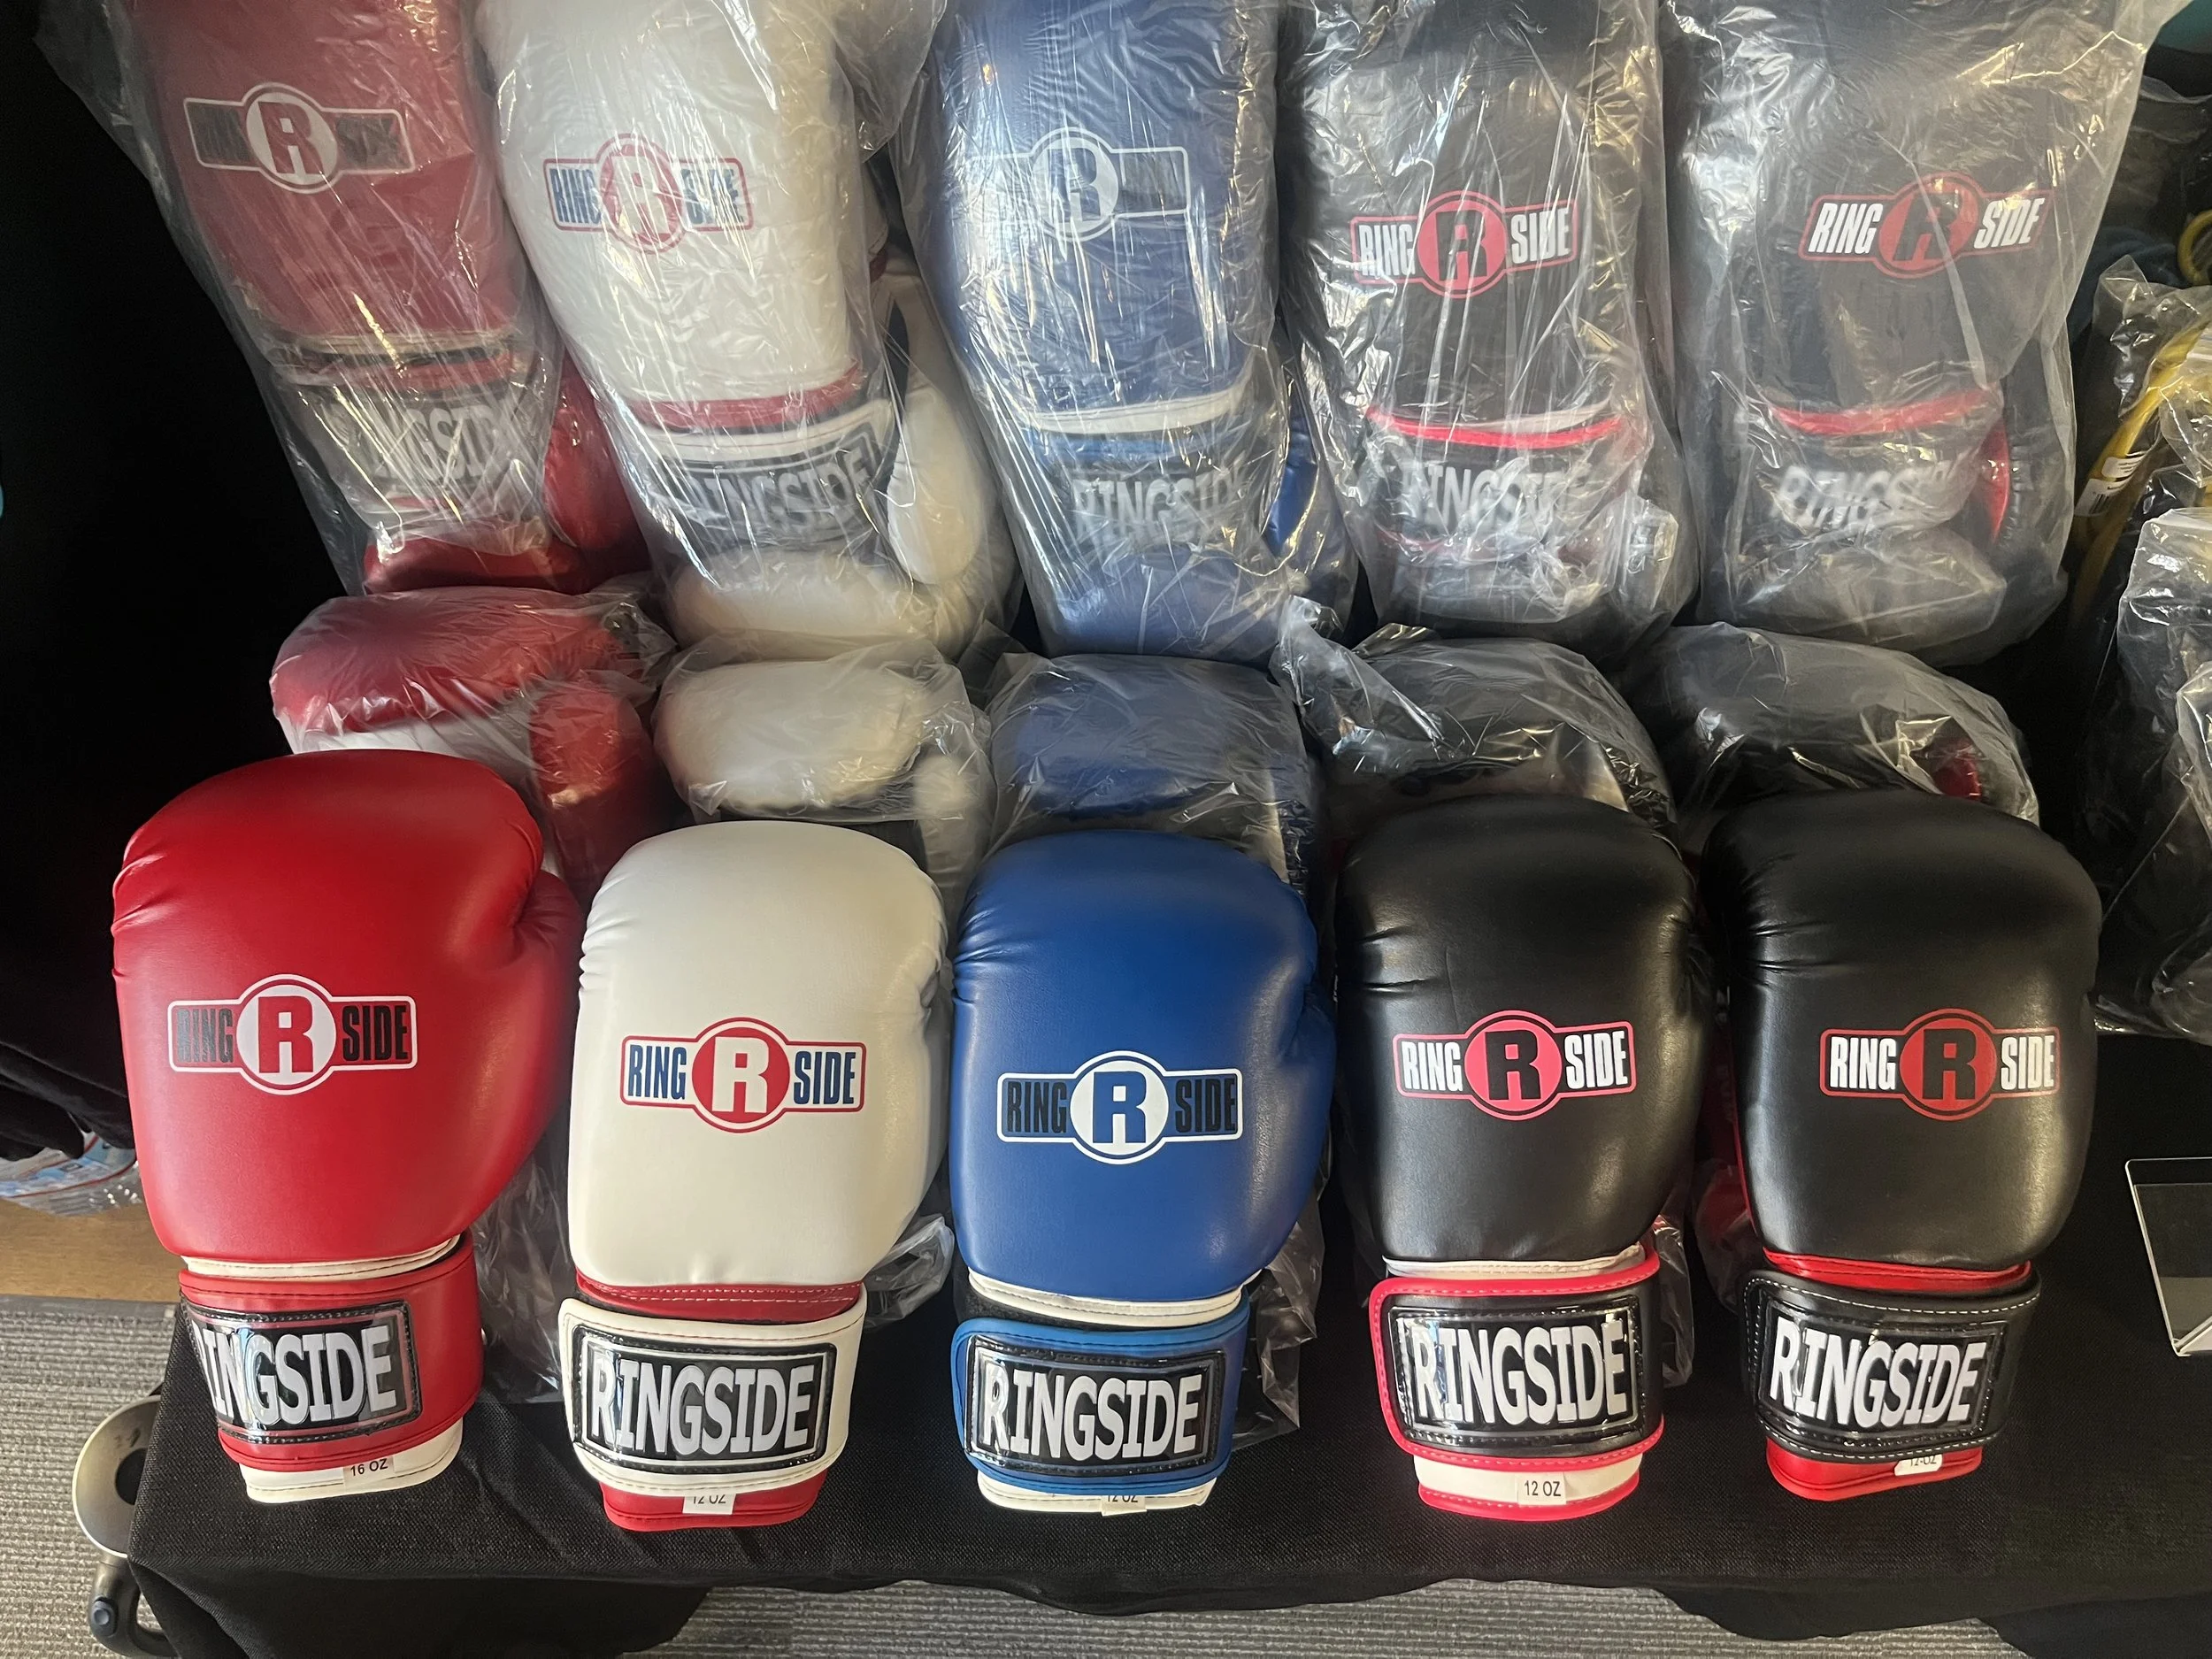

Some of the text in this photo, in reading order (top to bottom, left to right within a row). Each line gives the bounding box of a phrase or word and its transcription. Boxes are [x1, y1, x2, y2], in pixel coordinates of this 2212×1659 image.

[257, 102, 324, 174] R
[611, 155, 671, 234] R
[1047, 147, 1102, 221] R
[1358, 208, 1571, 281] RING R SIDE
[1808, 191, 2045, 261] RING R SIDE
[177, 995, 408, 1073] RING R SIDE
[1401, 1029, 1628, 1101] RING R SIDE
[1830, 1028, 2055, 1100] RING R SIDE
[628, 1036, 856, 1114] RING R SIDE
[1007, 1071, 1237, 1143] RING R SIDE
[590, 1355, 815, 1455] RINGSIDE
[1409, 1318, 1627, 1425] RINGSIDE
[1770, 1316, 1987, 1429] RINGSIDE
[981, 1362, 1202, 1462] RINGSIDE
[350, 1458, 388, 1477] 16 OZ
[1525, 1479, 1562, 1497] 12 OZ
